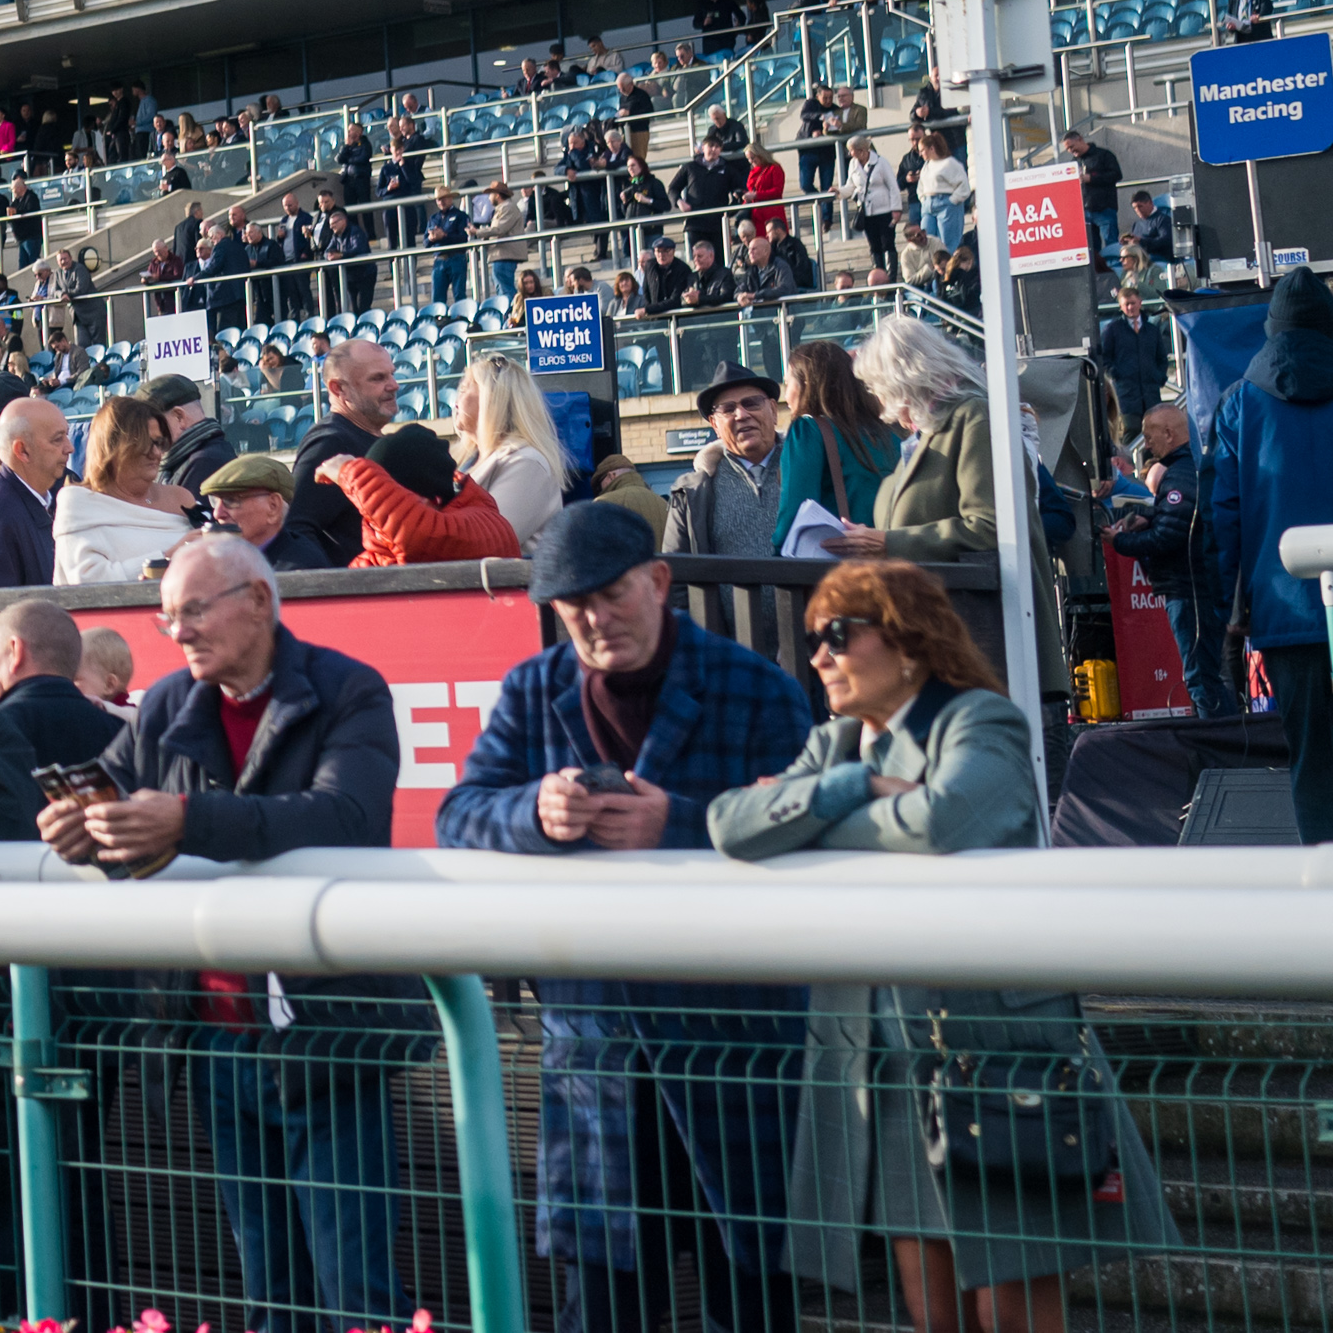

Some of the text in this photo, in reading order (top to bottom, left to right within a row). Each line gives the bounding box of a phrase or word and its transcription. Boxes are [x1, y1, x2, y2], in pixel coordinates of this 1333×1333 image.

[1199, 71, 1328, 103] Manchester
[1229, 101, 1303, 124] Racing
[1008, 169, 1063, 184] CARDS ACCEPTED VISA
[1007, 196, 1058, 226] A&A
[1007, 223, 1064, 245] RACING
[1018, 261, 1034, 269] CARDS
[1034, 258, 1057, 267] ACCEPTED
[532, 301, 593, 325] Derrick
[154, 336, 203, 360] JAYNE
[537, 326, 592, 352] Wright
[538, 353, 593, 367] EURO'S TAKEN
[1130, 593, 1166, 610] RACIN
[1153, 668, 1169, 682] 18+
[389, 680, 505, 789] ET
